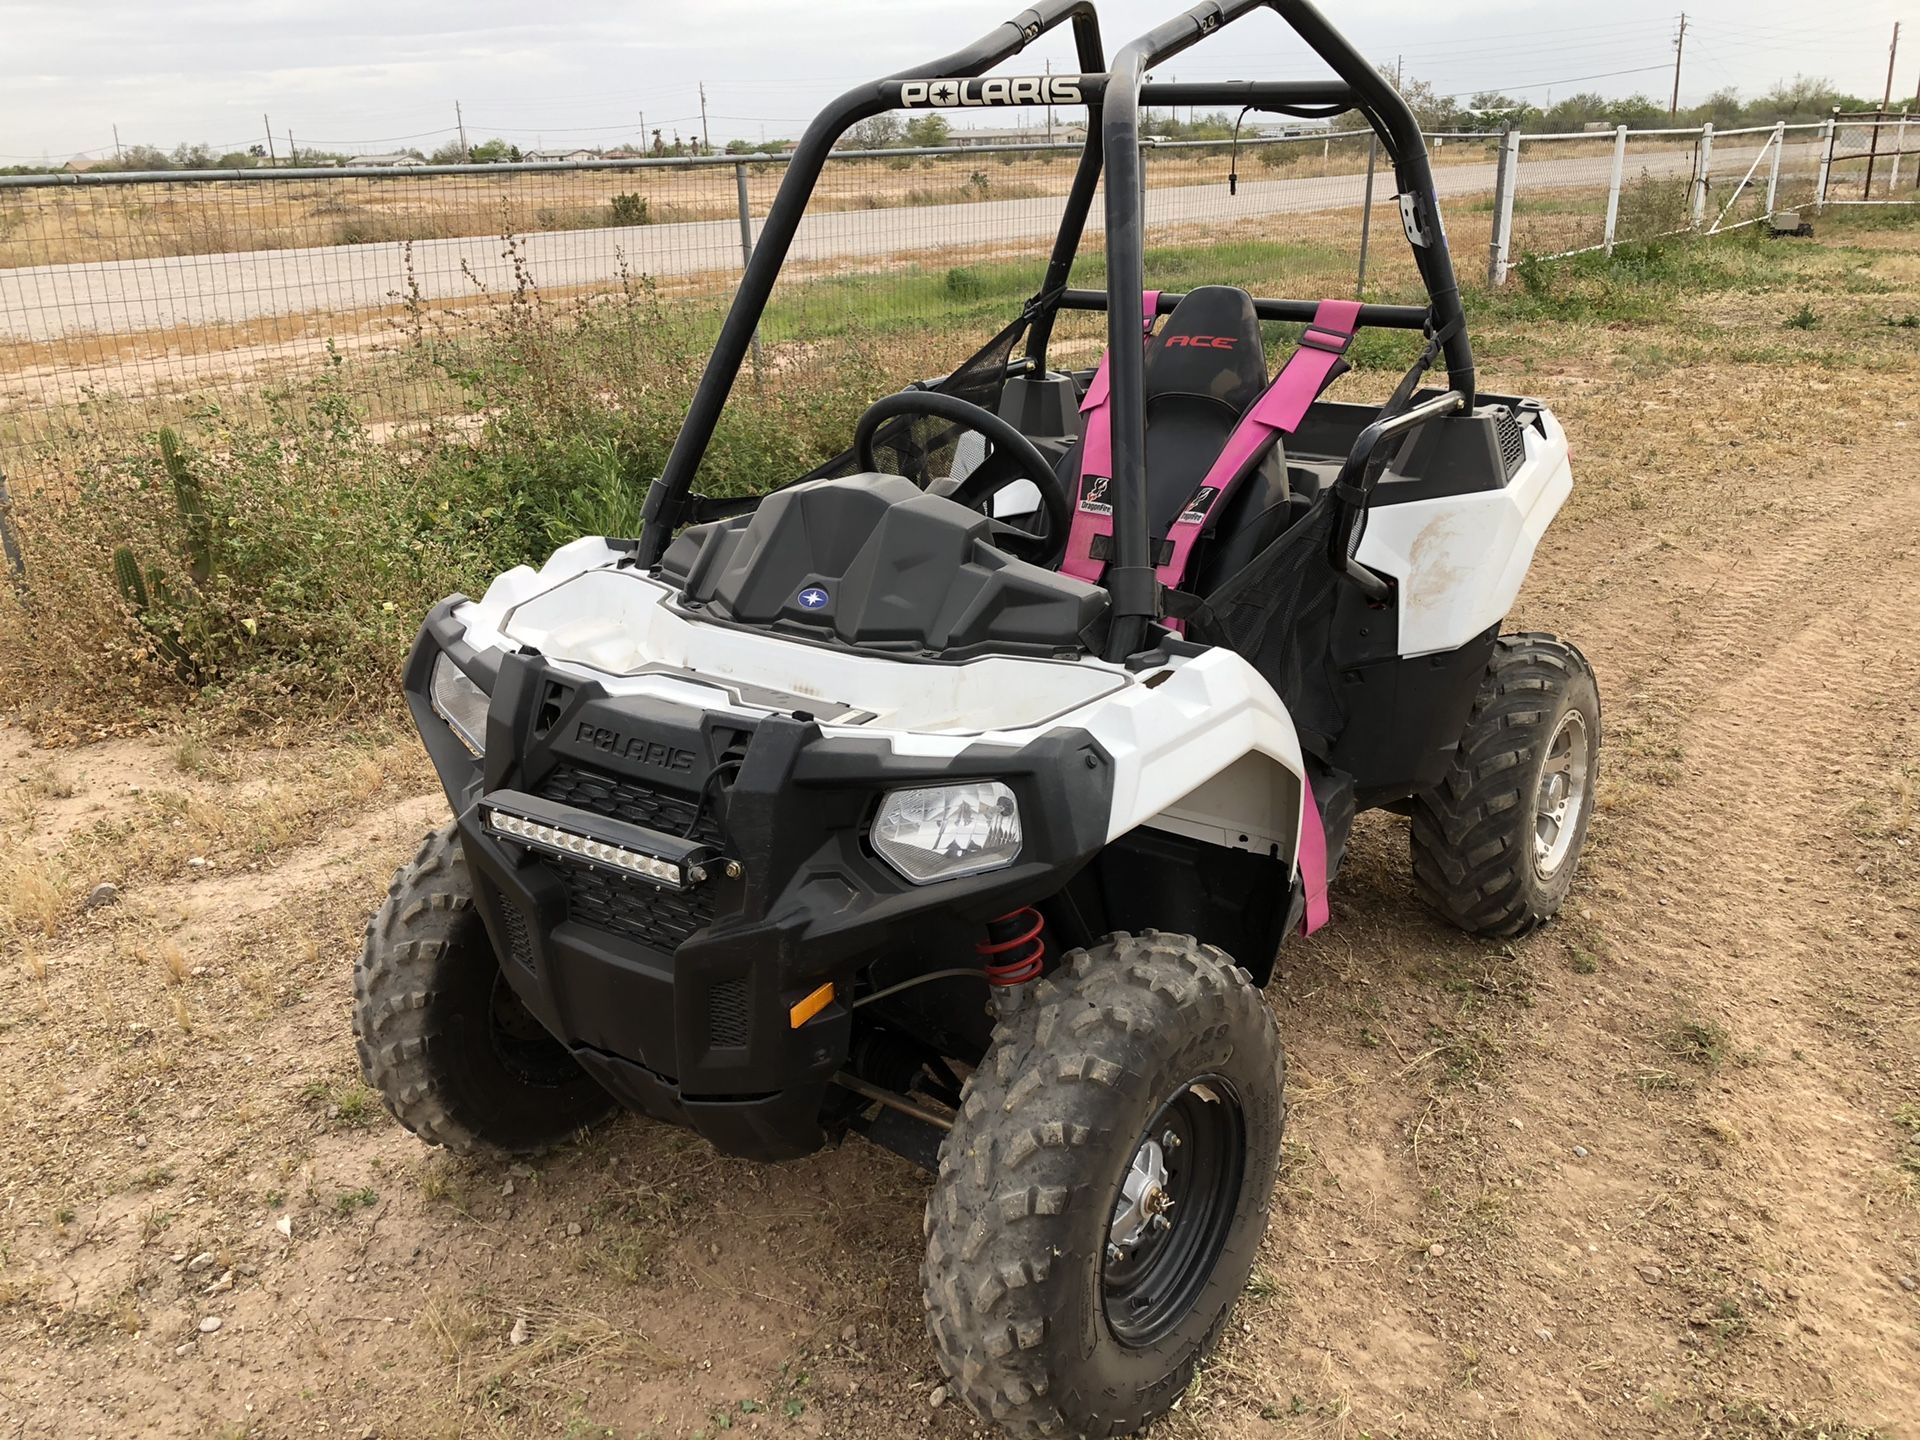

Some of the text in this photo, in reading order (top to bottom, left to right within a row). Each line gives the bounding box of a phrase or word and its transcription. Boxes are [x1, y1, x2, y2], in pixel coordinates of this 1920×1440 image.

[901, 77, 1082, 107] POLARIS
[1165, 335, 1238, 350] ACE
[575, 722, 697, 774] POLARIS
